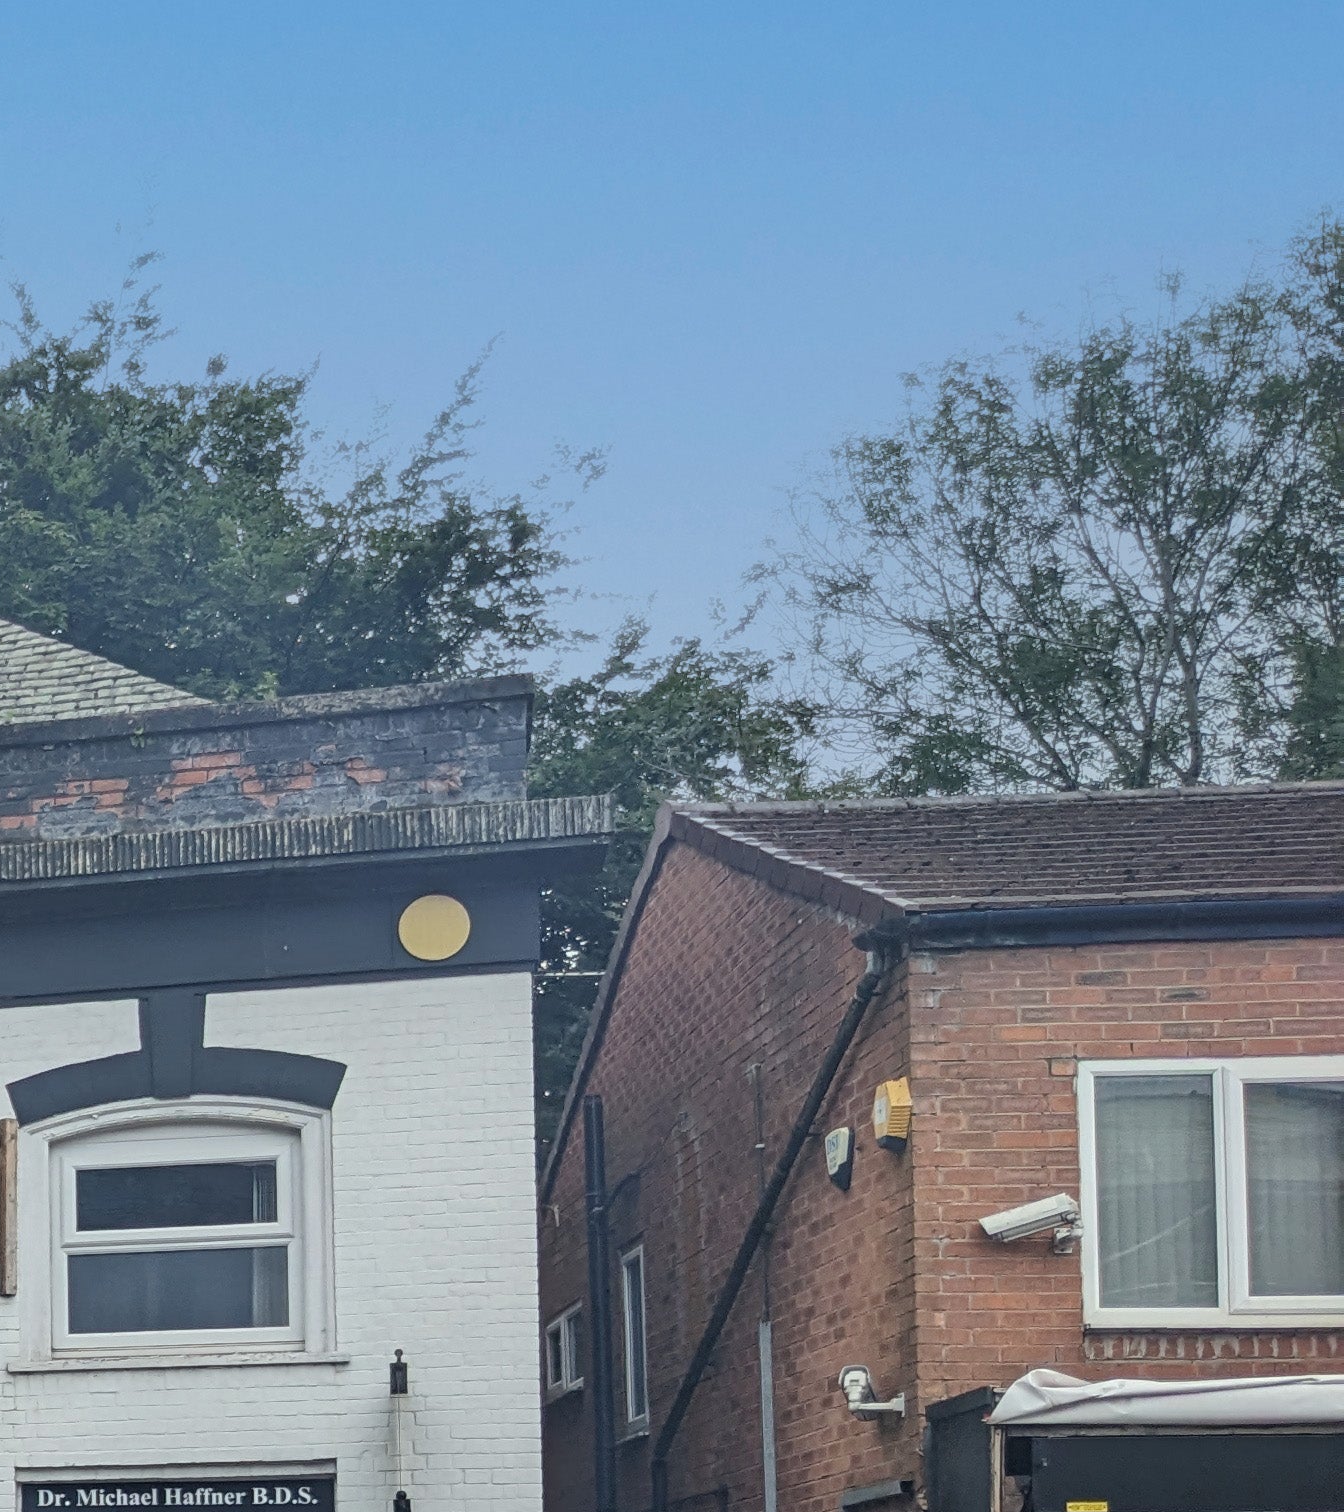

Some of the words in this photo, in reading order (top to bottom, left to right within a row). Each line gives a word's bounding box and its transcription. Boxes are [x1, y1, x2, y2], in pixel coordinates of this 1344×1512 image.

[37, 1489, 70, 1507] Dr.
[77, 1488, 157, 1506] Michael
[164, 1488, 246, 1506] Haffner
[252, 1487, 318, 1505] B.D.S.
